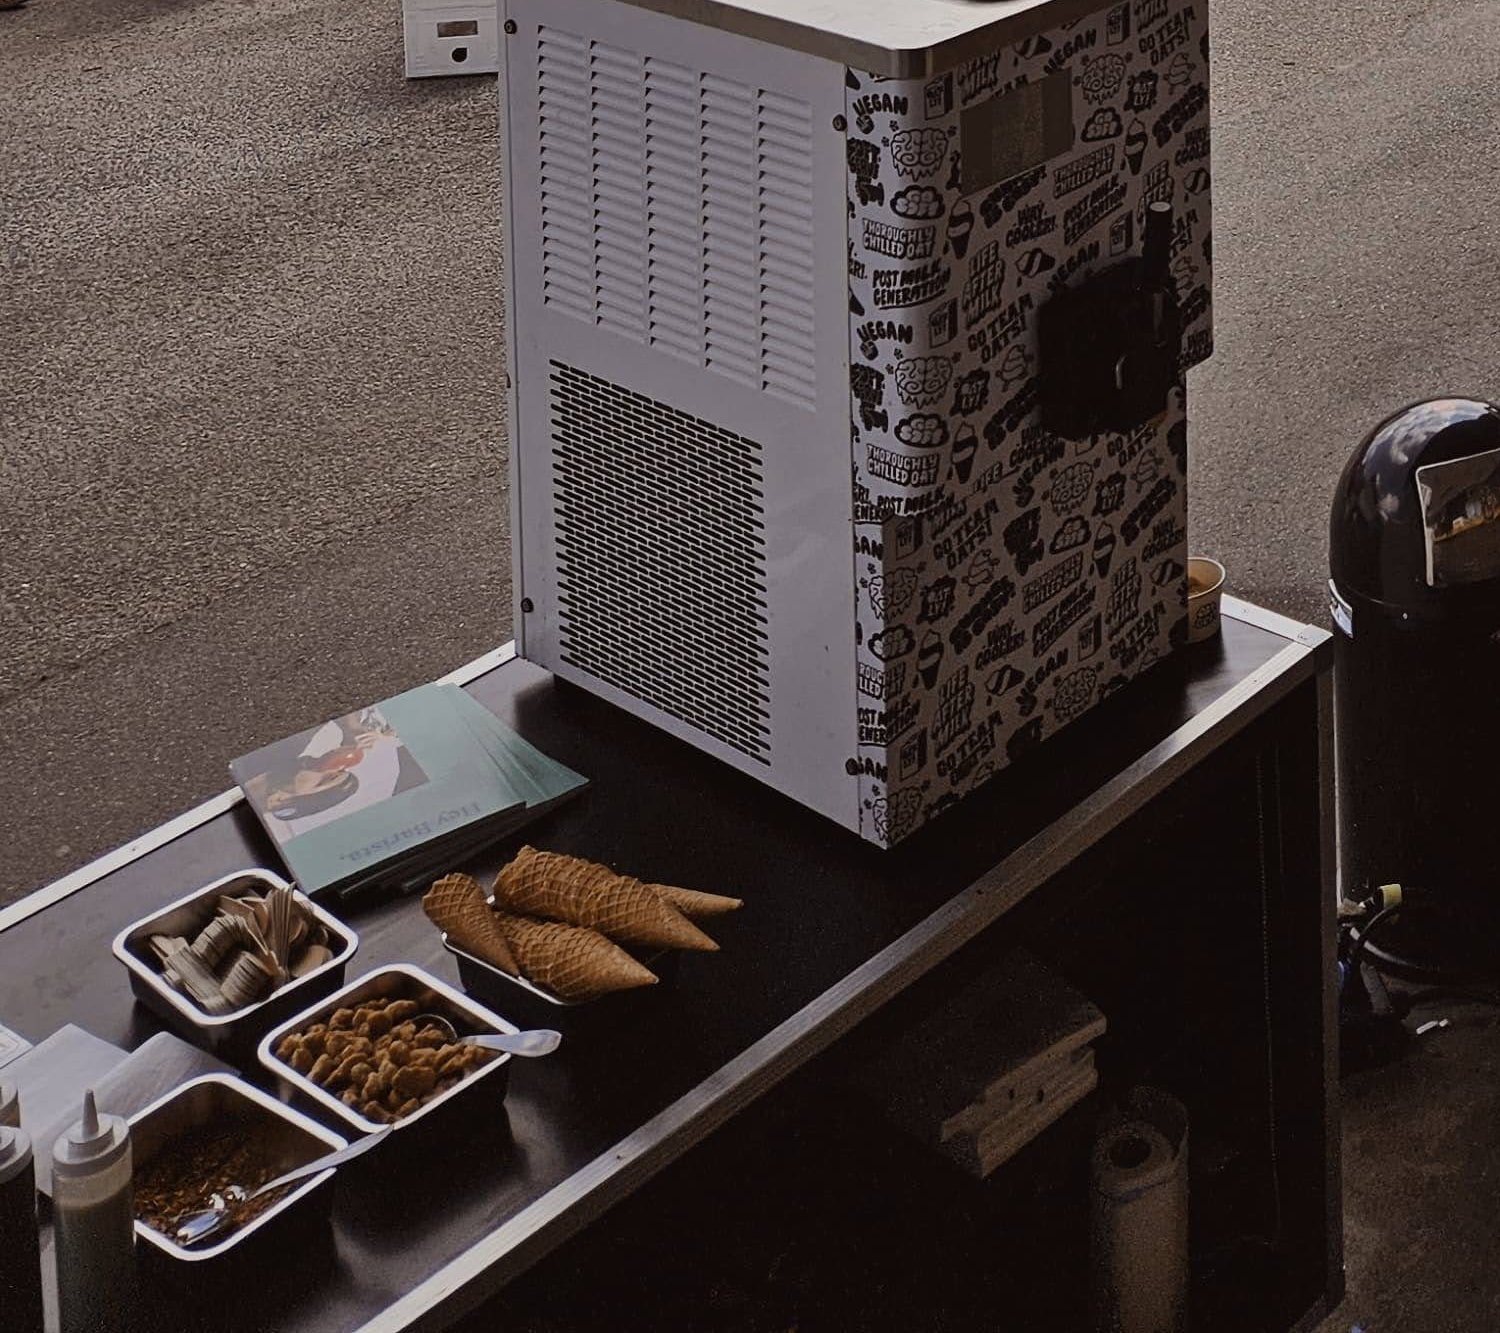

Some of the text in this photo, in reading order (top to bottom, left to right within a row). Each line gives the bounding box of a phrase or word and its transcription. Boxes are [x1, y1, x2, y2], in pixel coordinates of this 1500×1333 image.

[861, 218, 936, 242] THOROUGHLY
[862, 232, 904, 260] CHILLED
[873, 269, 899, 288] POST
